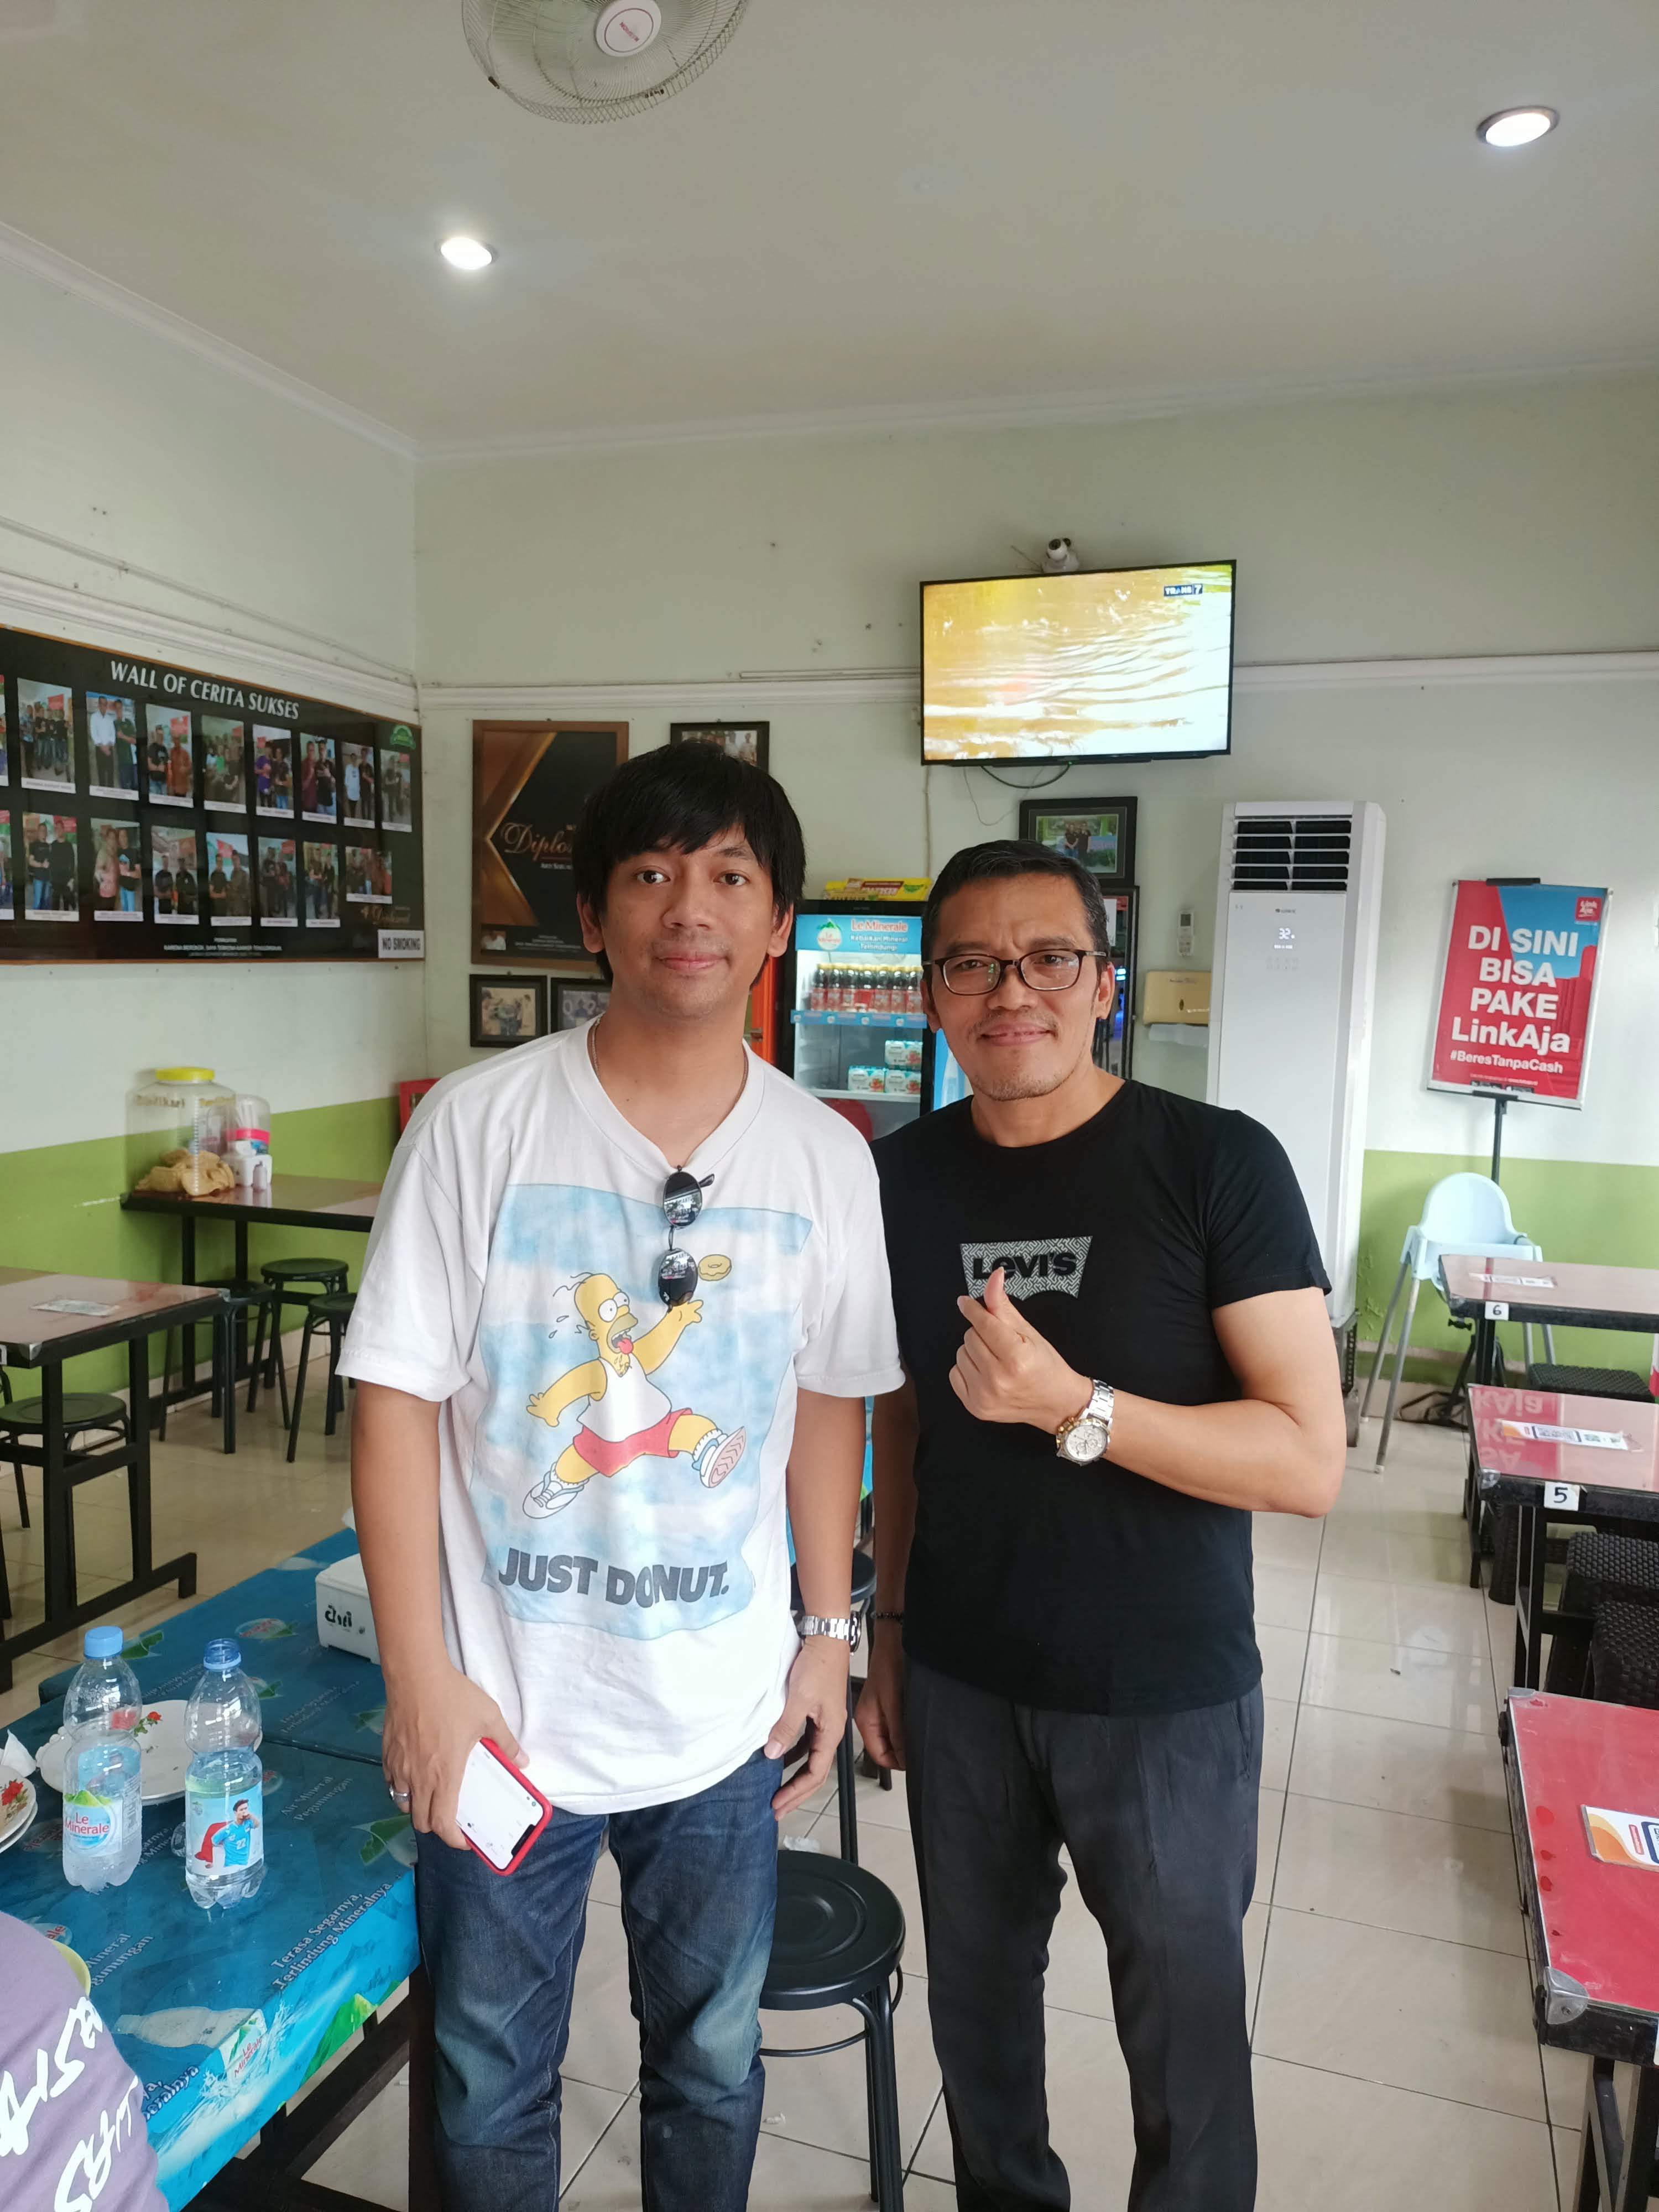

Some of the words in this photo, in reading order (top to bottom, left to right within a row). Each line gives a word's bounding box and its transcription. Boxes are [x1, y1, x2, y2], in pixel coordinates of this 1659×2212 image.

[111, 660, 158, 690] WALL
[163, 674, 187, 695] OF
[190, 679, 244, 708] CERITA
[248, 692, 300, 719] SUKSES
[500, 822, 572, 862] Diplo
[851, 919, 863, 931] Le
[865, 920, 908, 932] Minerale
[1468, 925, 1501, 952] DI
[1510, 928, 1579, 957] SINI
[382, 937, 392, 951] NO
[393, 937, 421, 951] SMOKING
[1479, 957, 1557, 988] BISA
[1470, 987, 1559, 1020] PAKE
[1451, 1016, 1571, 1056] LinkAja
[1449, 1050, 1564, 1074] #BeresTanpaCash
[1492, 1305, 1502, 1316] 6
[1553, 1487, 1568, 1504] 5
[498, 1547, 599, 1595] JUST
[605, 1561, 729, 1609] DONUT.
[65, 1818, 109, 1835] Minerale
[75, 1812, 89, 1825] Le
[270, 1937, 314, 1969] Terasa
[308, 1893, 363, 1936] Segarnya,
[272, 1934, 339, 1990] Terlindung
[332, 1882, 393, 1934] Mineralnya
[91, 1936, 154, 1987] gunungan
